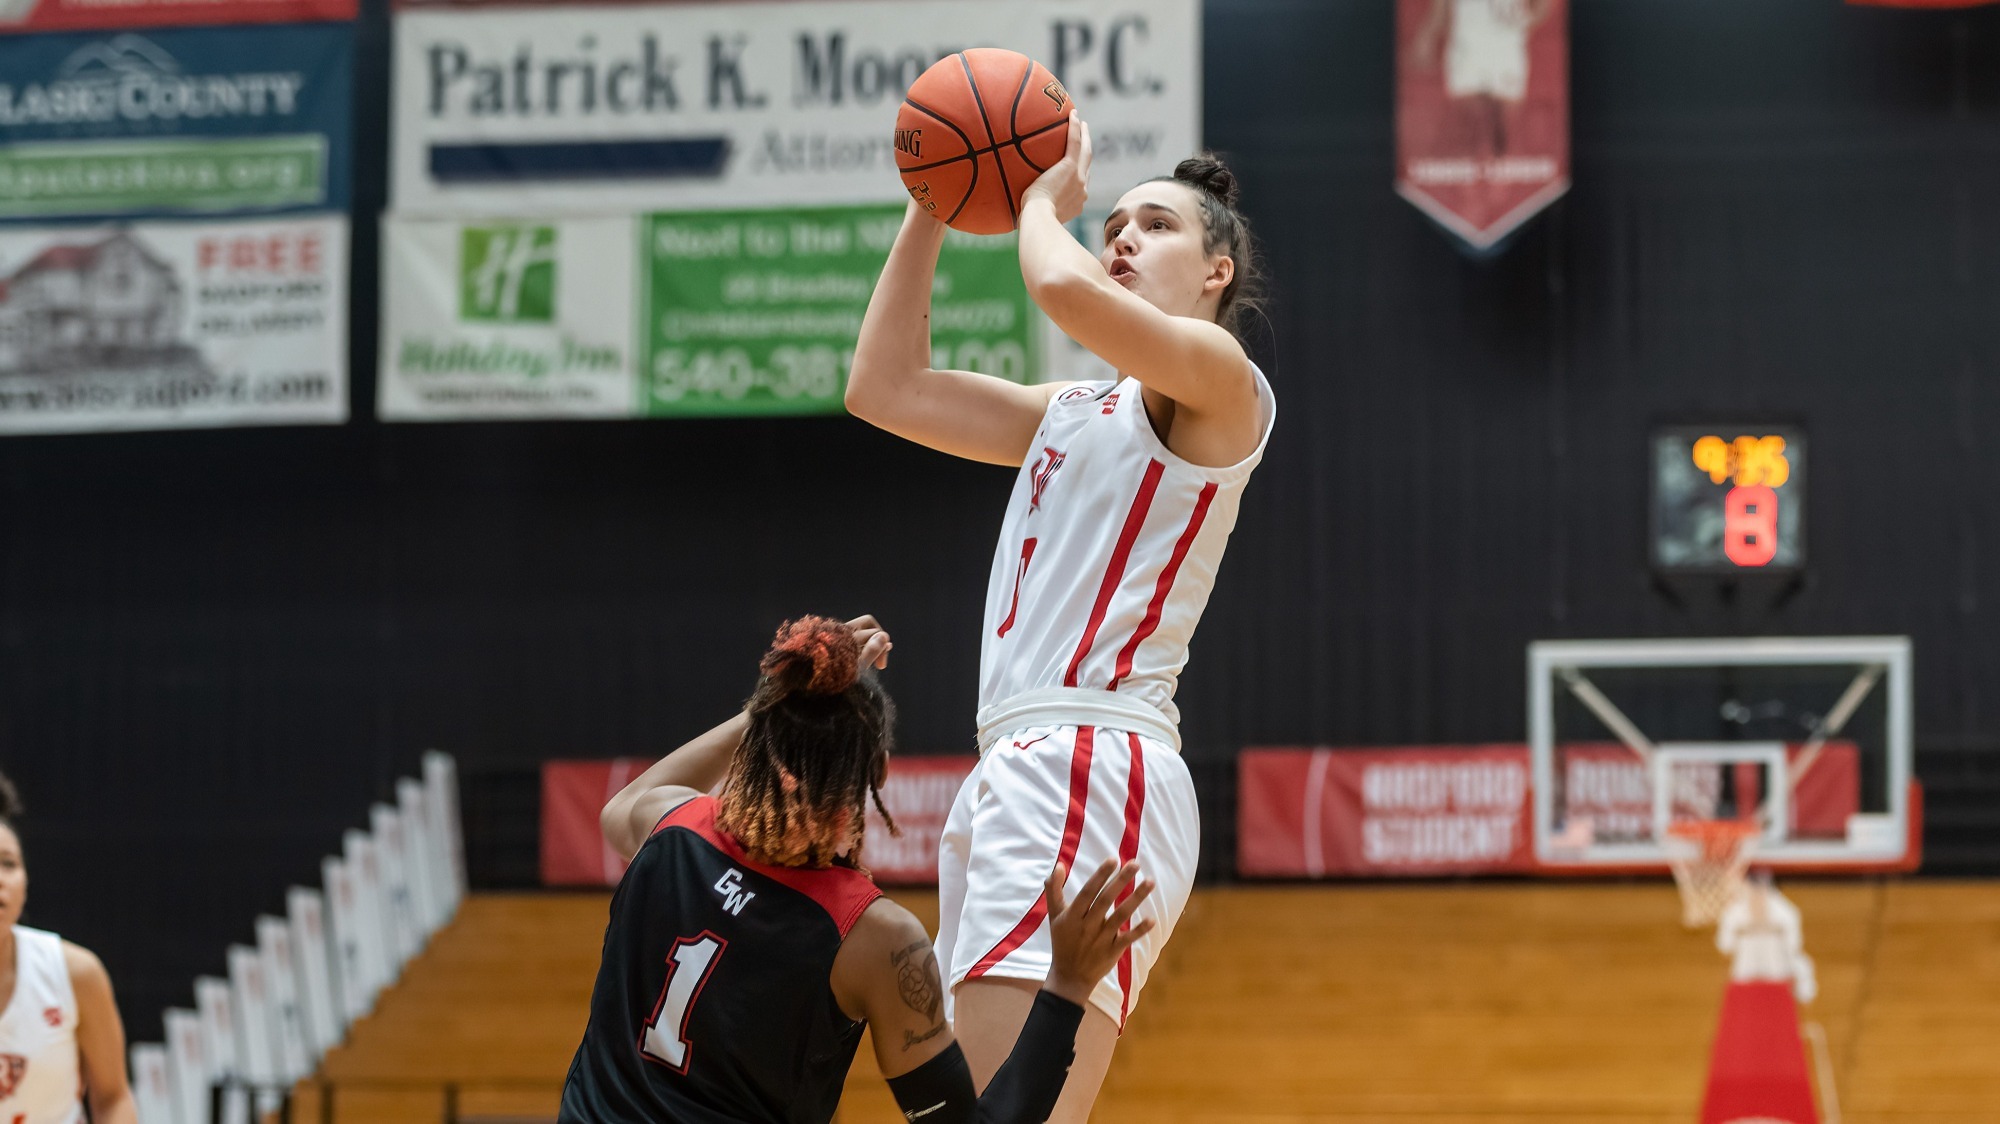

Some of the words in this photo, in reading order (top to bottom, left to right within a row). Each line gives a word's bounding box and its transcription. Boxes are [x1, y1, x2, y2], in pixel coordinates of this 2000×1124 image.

[428, 33, 681, 117] Patrick
[706, 32, 768, 110] K.
[1050, 15, 1167, 98] P.C.
[118, 70, 301, 121] COUNTY
[196, 236, 324, 274] FREE
[399, 336, 550, 380] Holiday
[558, 332, 623, 373] Inn
[1724, 484, 1778, 567] 8
[714, 867, 756, 917] GW
[638, 929, 729, 1077] 1
